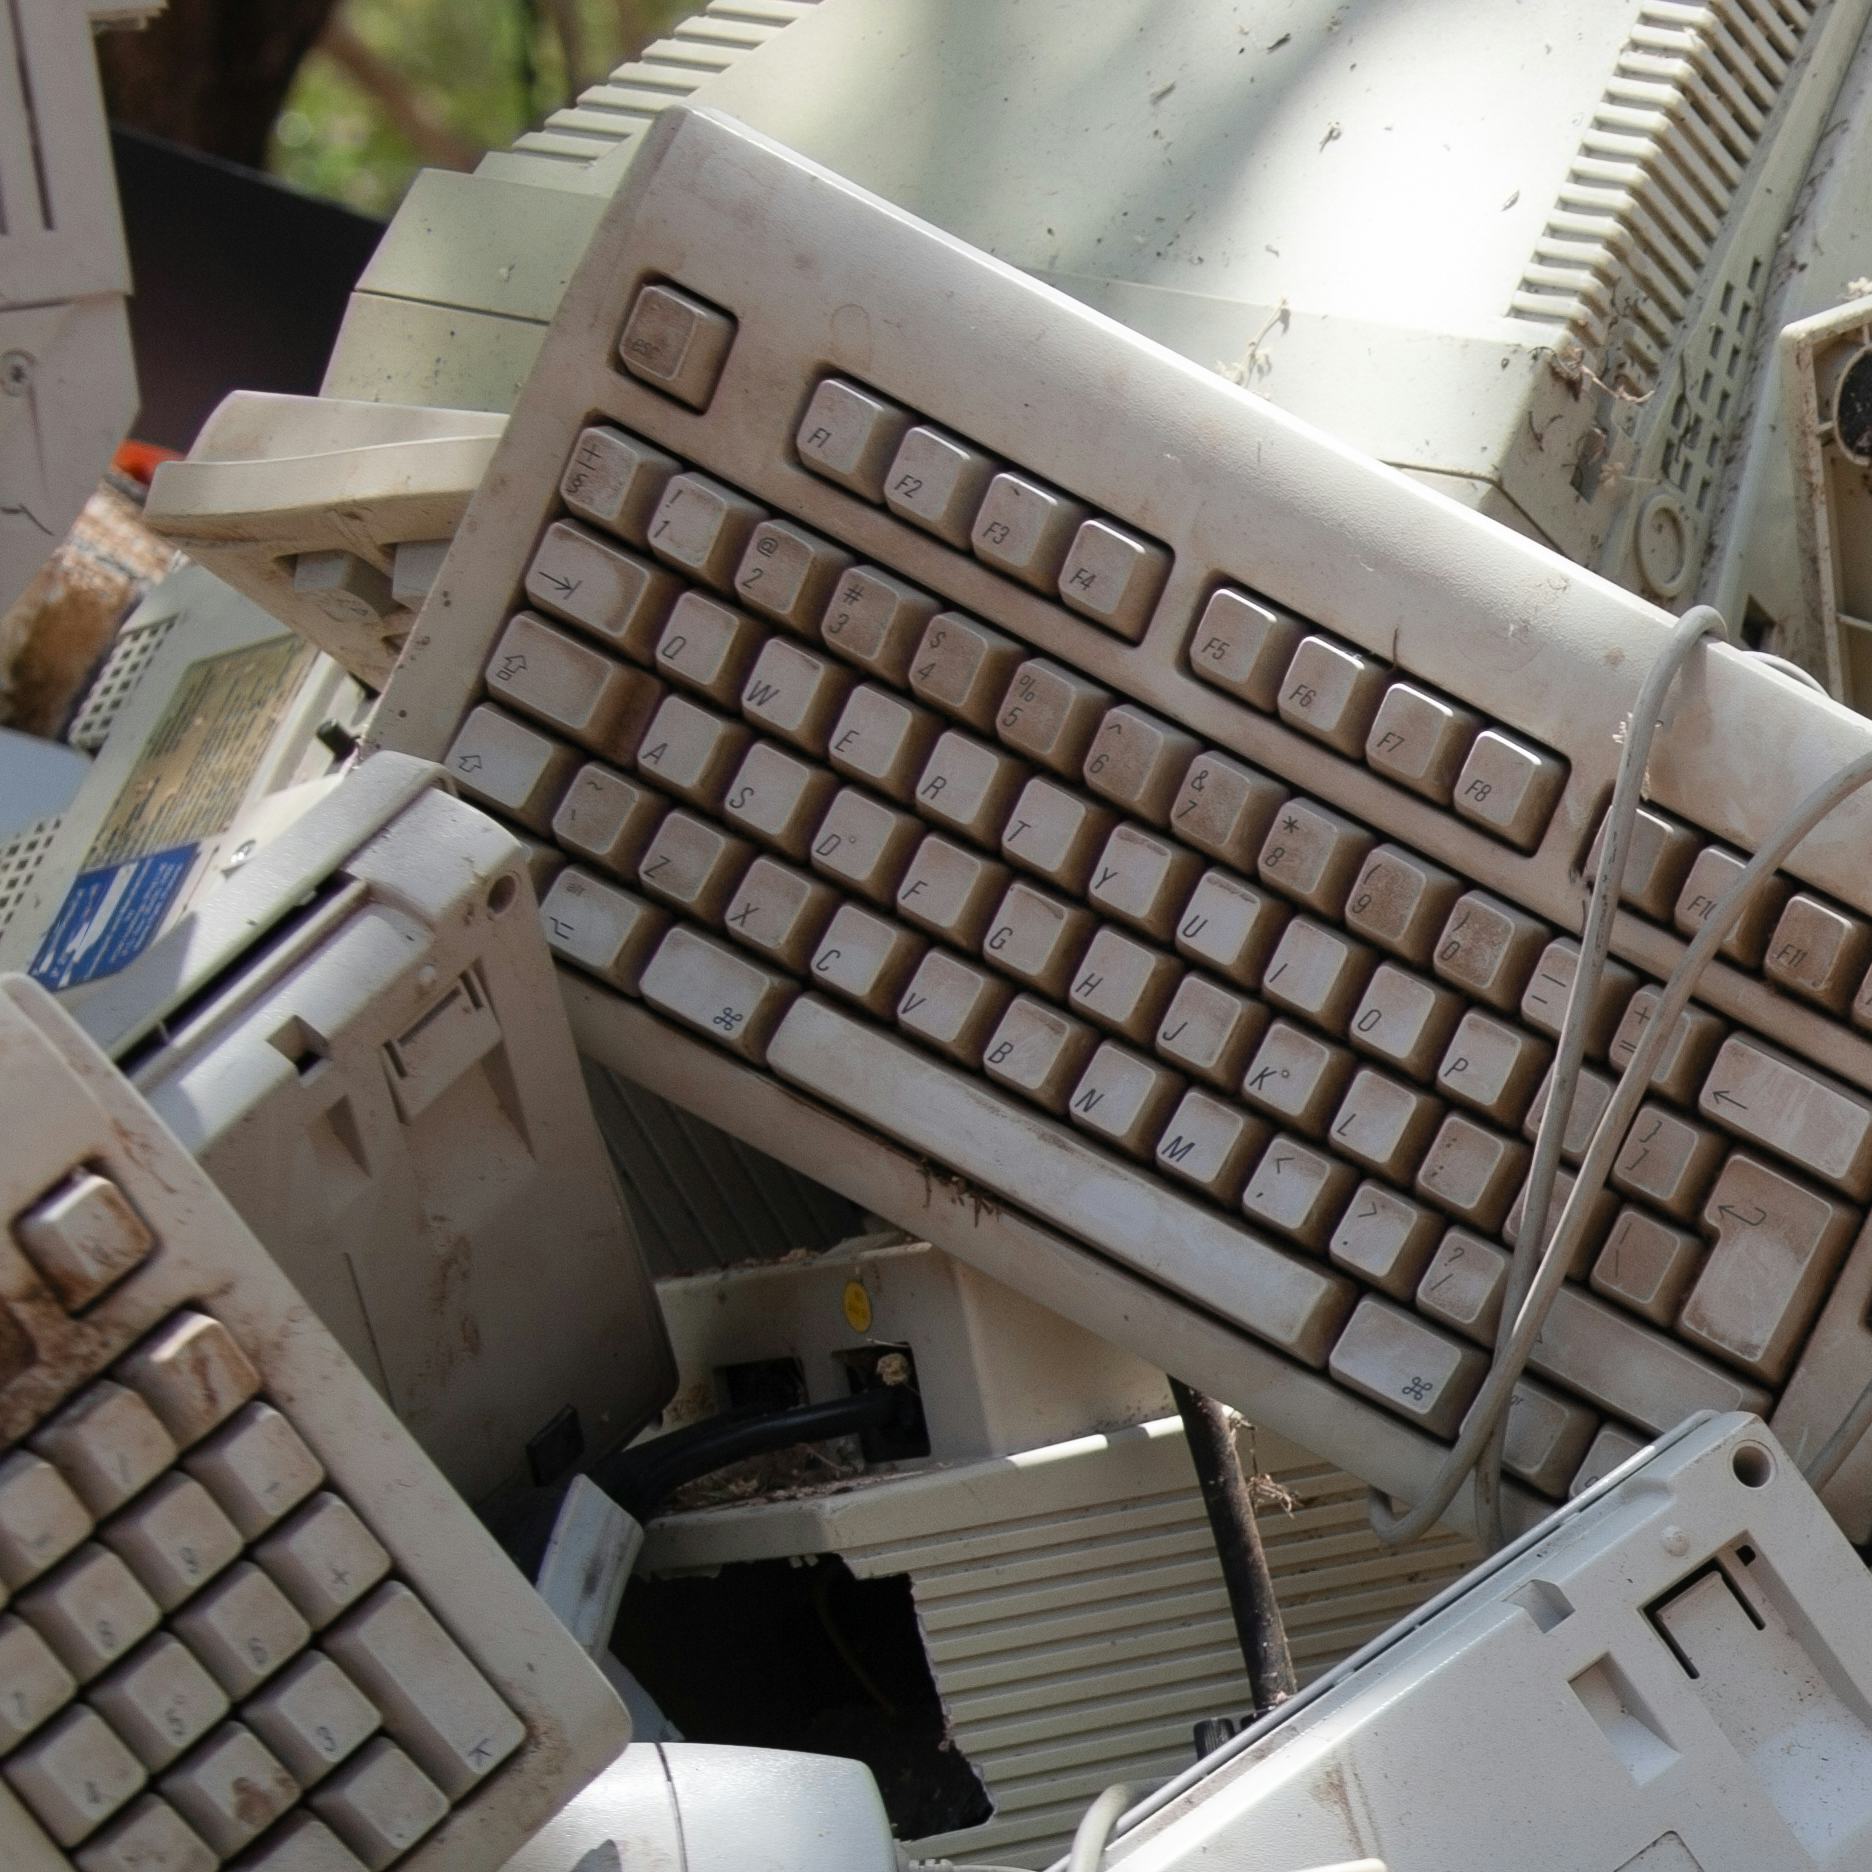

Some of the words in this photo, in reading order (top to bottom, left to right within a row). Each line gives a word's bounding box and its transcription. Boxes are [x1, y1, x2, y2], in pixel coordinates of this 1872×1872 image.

[807, 428, 832, 450] F1
[894, 474, 922, 499] F2
[981, 522, 1011, 545] F3
[1069, 567, 1096, 592] F4
[1203, 637, 1229, 661] F5
[748, 683, 778, 709] W
[1290, 684, 1316, 709] F6
[643, 742, 667, 765] A
[834, 731, 859, 755] E
[1377, 731, 1405, 754] F7
[730, 786, 754, 810] S
[921, 776, 947, 799] R
[1464, 779, 1493, 803] F8
[1006, 821, 1031, 843] T
[816, 833, 842, 857] D
[644, 855, 671, 878] Z
[1094, 867, 1118, 890] Y
[902, 879, 927, 902] F
[730, 903, 758, 927] X
[1182, 916, 1204, 938] U
[988, 926, 1012, 950] G
[816, 949, 840, 973] C
[1777, 942, 1806, 969] F11
[1076, 973, 1102, 996] H
[901, 992, 925, 1016] V
[1163, 1020, 1188, 1042] J
[988, 1042, 1013, 1065] B
[1250, 1066, 1273, 1090] K
[1444, 1057, 1469, 1078] P
[1075, 1088, 1102, 1112] N
[1335, 1113, 1354, 1135] L
[1162, 1135, 1194, 1161] M
